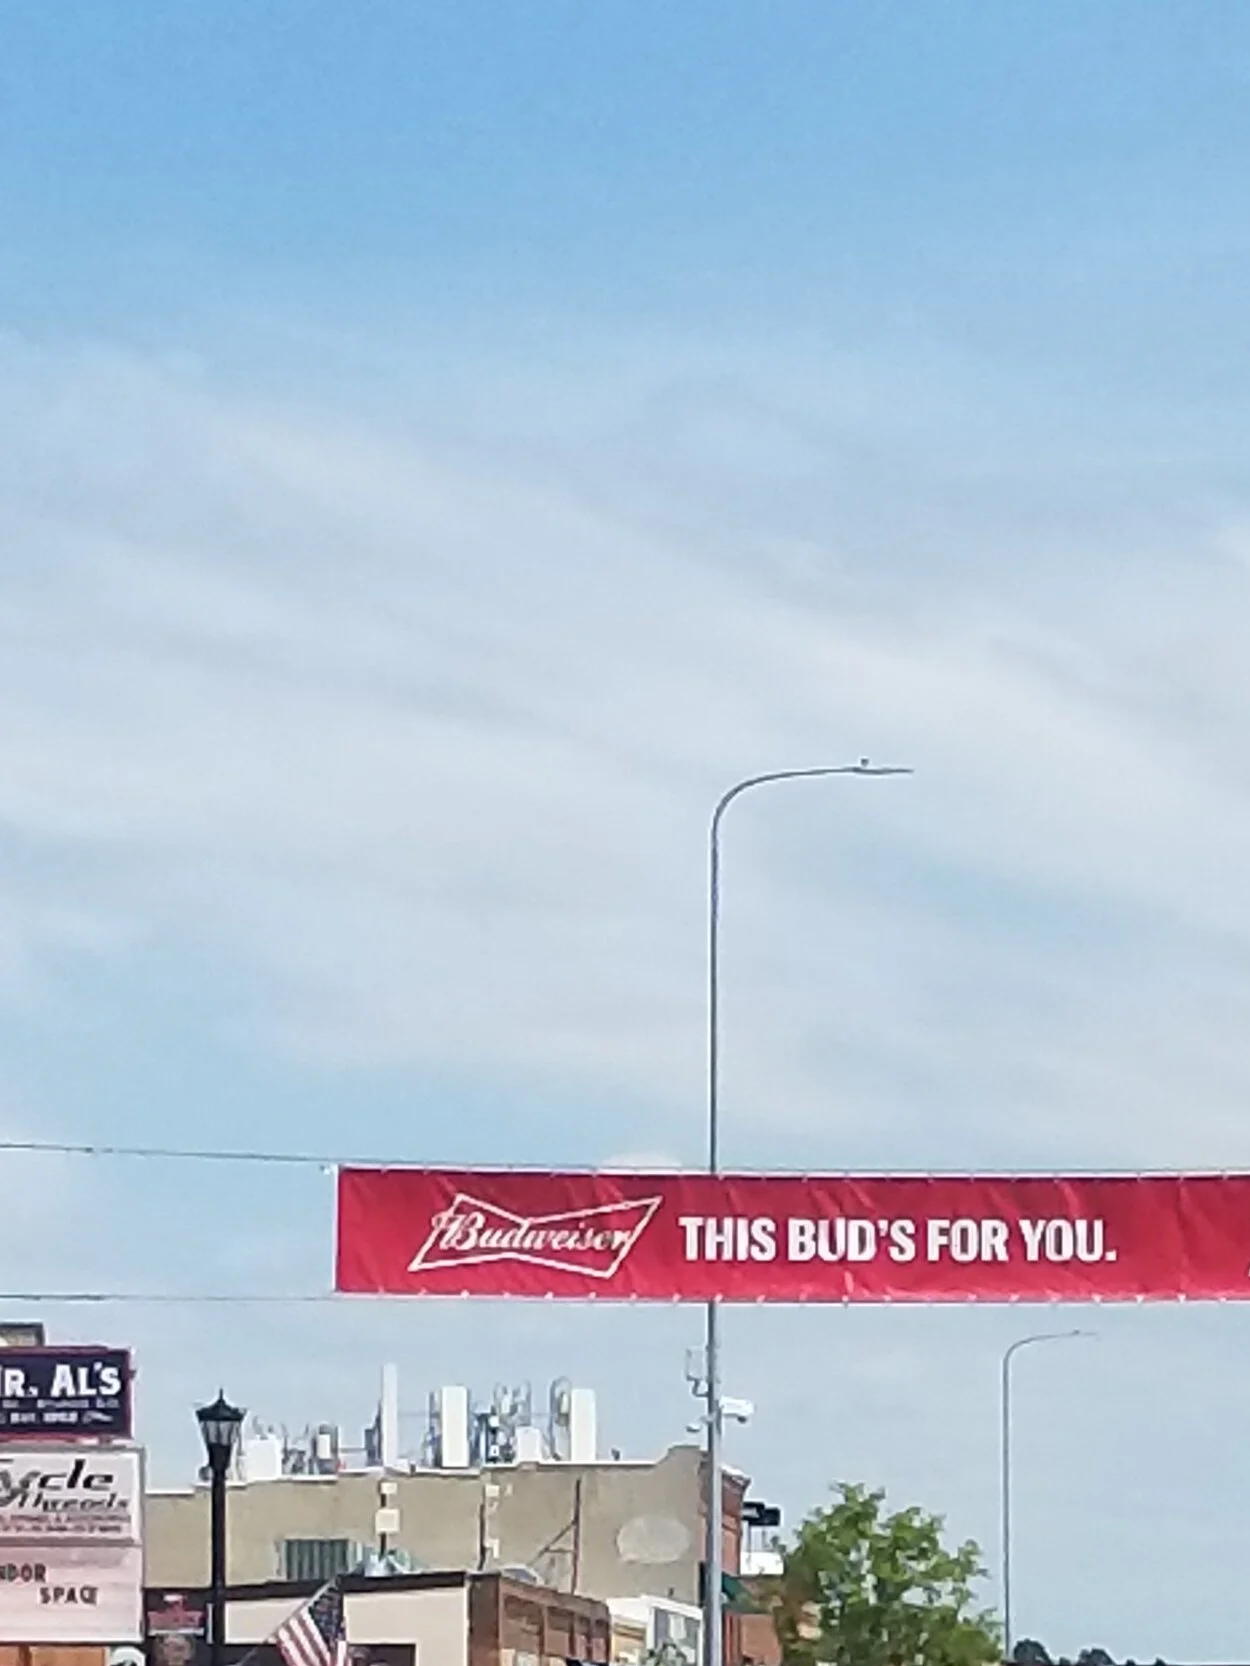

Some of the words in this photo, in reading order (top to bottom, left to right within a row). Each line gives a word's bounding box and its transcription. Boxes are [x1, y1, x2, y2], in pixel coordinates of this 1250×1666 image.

[431, 1207, 634, 1252] Budweiser
[678, 1216, 777, 1262] THIS
[788, 1217, 917, 1262] BUD'S
[927, 1218, 1009, 1262] FOR
[1018, 1218, 1118, 1262] YOU.
[50, 1361, 122, 1397] AL'S
